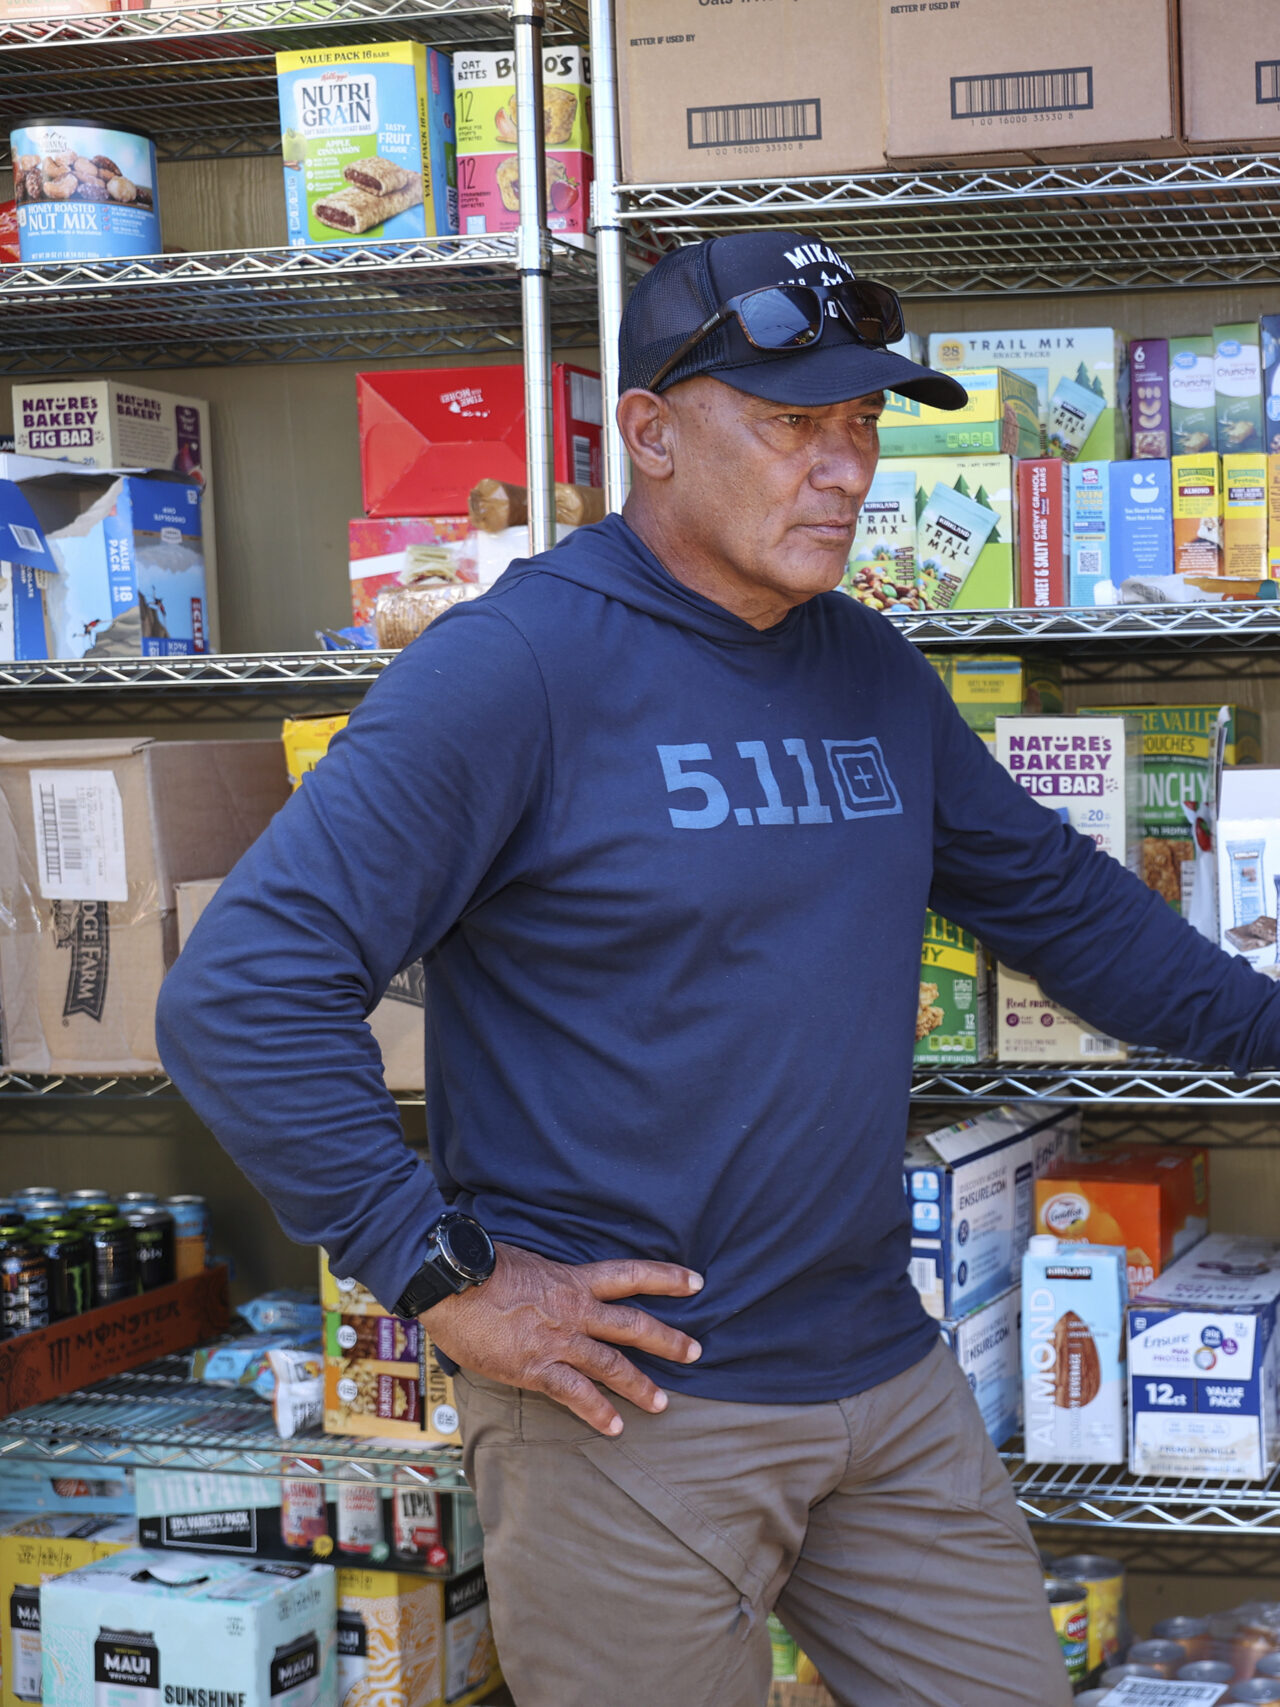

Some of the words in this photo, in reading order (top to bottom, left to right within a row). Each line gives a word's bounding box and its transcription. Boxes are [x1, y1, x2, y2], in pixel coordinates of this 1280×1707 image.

[890, 5, 918, 14] BETTER
[929, 2, 948, 11] USED
[950, 1, 960, 9] BY
[630, 38, 656, 47] BETTER
[657, 36, 664, 44] IF
[666, 35, 684, 44] USED
[685, 34, 696, 42] BY
[300, 54, 331, 64] VALUE
[334, 52, 360, 62] PACK
[362, 50, 372, 60] 16
[462, 60, 481, 70] OAT
[458, 70, 487, 80] BITES
[302, 81, 371, 107] NUTRI
[302, 99, 372, 126] GRAIN
[458, 91, 474, 122] 12
[384, 123, 407, 131] TASTY
[326, 139, 352, 148] APPLE
[379, 132, 412, 145] FRUIT
[381, 145, 408, 154] FLAVOR
[460, 158, 477, 189] 12
[28, 204, 52, 213] HONEY
[54, 203, 95, 213] ROASTED
[29, 214, 57, 230] NUT
[64, 213, 97, 230] MIX
[942, 346, 960, 357] 28
[969, 339, 1026, 351] TRAIL
[1039, 338, 1075, 349] MIX
[1133, 346, 1145, 362] 6
[1216, 366, 1257, 377] Crunchy
[1173, 376, 1212, 389] Crunchy
[23, 411, 98, 428] BAKERY
[116, 404, 161, 422] BAKERY
[31, 431, 56, 447] FIG
[60, 430, 91, 446] BAR
[1183, 487, 1210, 495] ALMOND
[858, 514, 908, 525] TRAIL
[938, 517, 971, 539] KIRKLAND
[866, 525, 898, 535] MIX
[925, 523, 971, 556] TRAIL
[109, 540, 120, 572] PACK
[120, 539, 130, 571] VALUE
[928, 539, 958, 560] MIX
[1035, 540, 1048, 566] SALTY
[1034, 576, 1049, 606] SWEET
[1009, 754, 1112, 770] BAKERY
[656, 738, 833, 829] 5.11
[1021, 777, 1053, 794] FIG
[1062, 775, 1101, 794] BAR
[1088, 810, 1104, 821] 20
[77, 948, 100, 999] FARM
[959, 1179, 1007, 1211] ENSURE.COM
[1047, 1267, 1091, 1276] KIRKLAND
[76, 1300, 181, 1350] MONSTER
[380, 1319, 393, 1360] ALMONDS
[1144, 1333, 1190, 1349] Ensure
[1030, 1288, 1057, 1447] ALMOND
[430, 1364, 447, 1405] NUTS
[1205, 1386, 1245, 1398] VALUE
[380, 1376, 393, 1418] CASHEWS
[1145, 1383, 1187, 1407] 12ct
[1209, 1397, 1242, 1408] PACK
[404, 1493, 432, 1517] IPA
[104, 1653, 151, 1674] MAUI
[278, 1655, 314, 1682] MAUI
[164, 1685, 247, 1707] SUNSHINE
